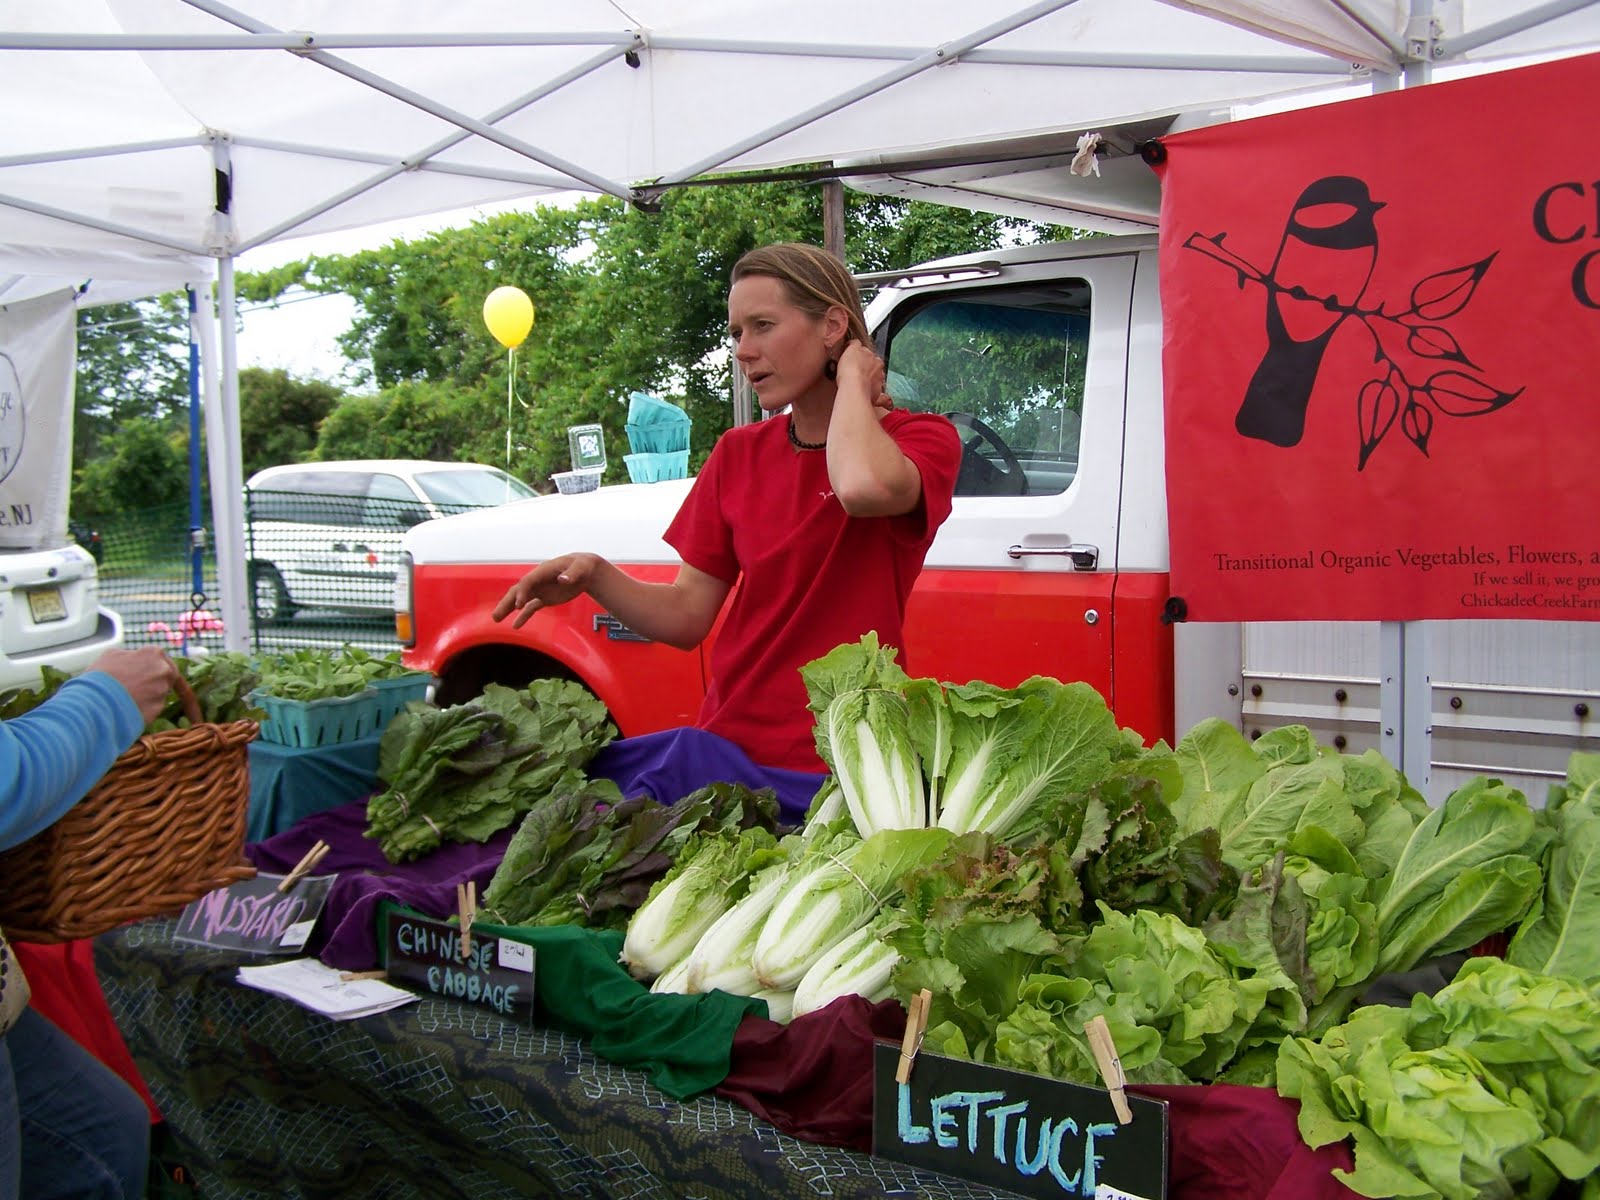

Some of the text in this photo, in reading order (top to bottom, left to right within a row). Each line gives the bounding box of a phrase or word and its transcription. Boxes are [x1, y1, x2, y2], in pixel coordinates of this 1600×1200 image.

[1213, 551, 1314, 571] Transitional
[1320, 550, 1391, 574] Organic
[1396, 546, 1500, 571] Vegetables,
[1508, 545, 1583, 566] Flowers,
[1473, 572, 1486, 586] If
[1490, 574, 1508, 585] we
[1512, 571, 1532, 585] sell
[1537, 573, 1550, 588] it,
[1554, 574, 1573, 586] we
[188, 887, 307, 945] MUSTARD
[397, 923, 495, 974] CHINESE
[427, 966, 520, 1014] CABBAGE
[897, 1082, 1118, 1198] LETTUCE
